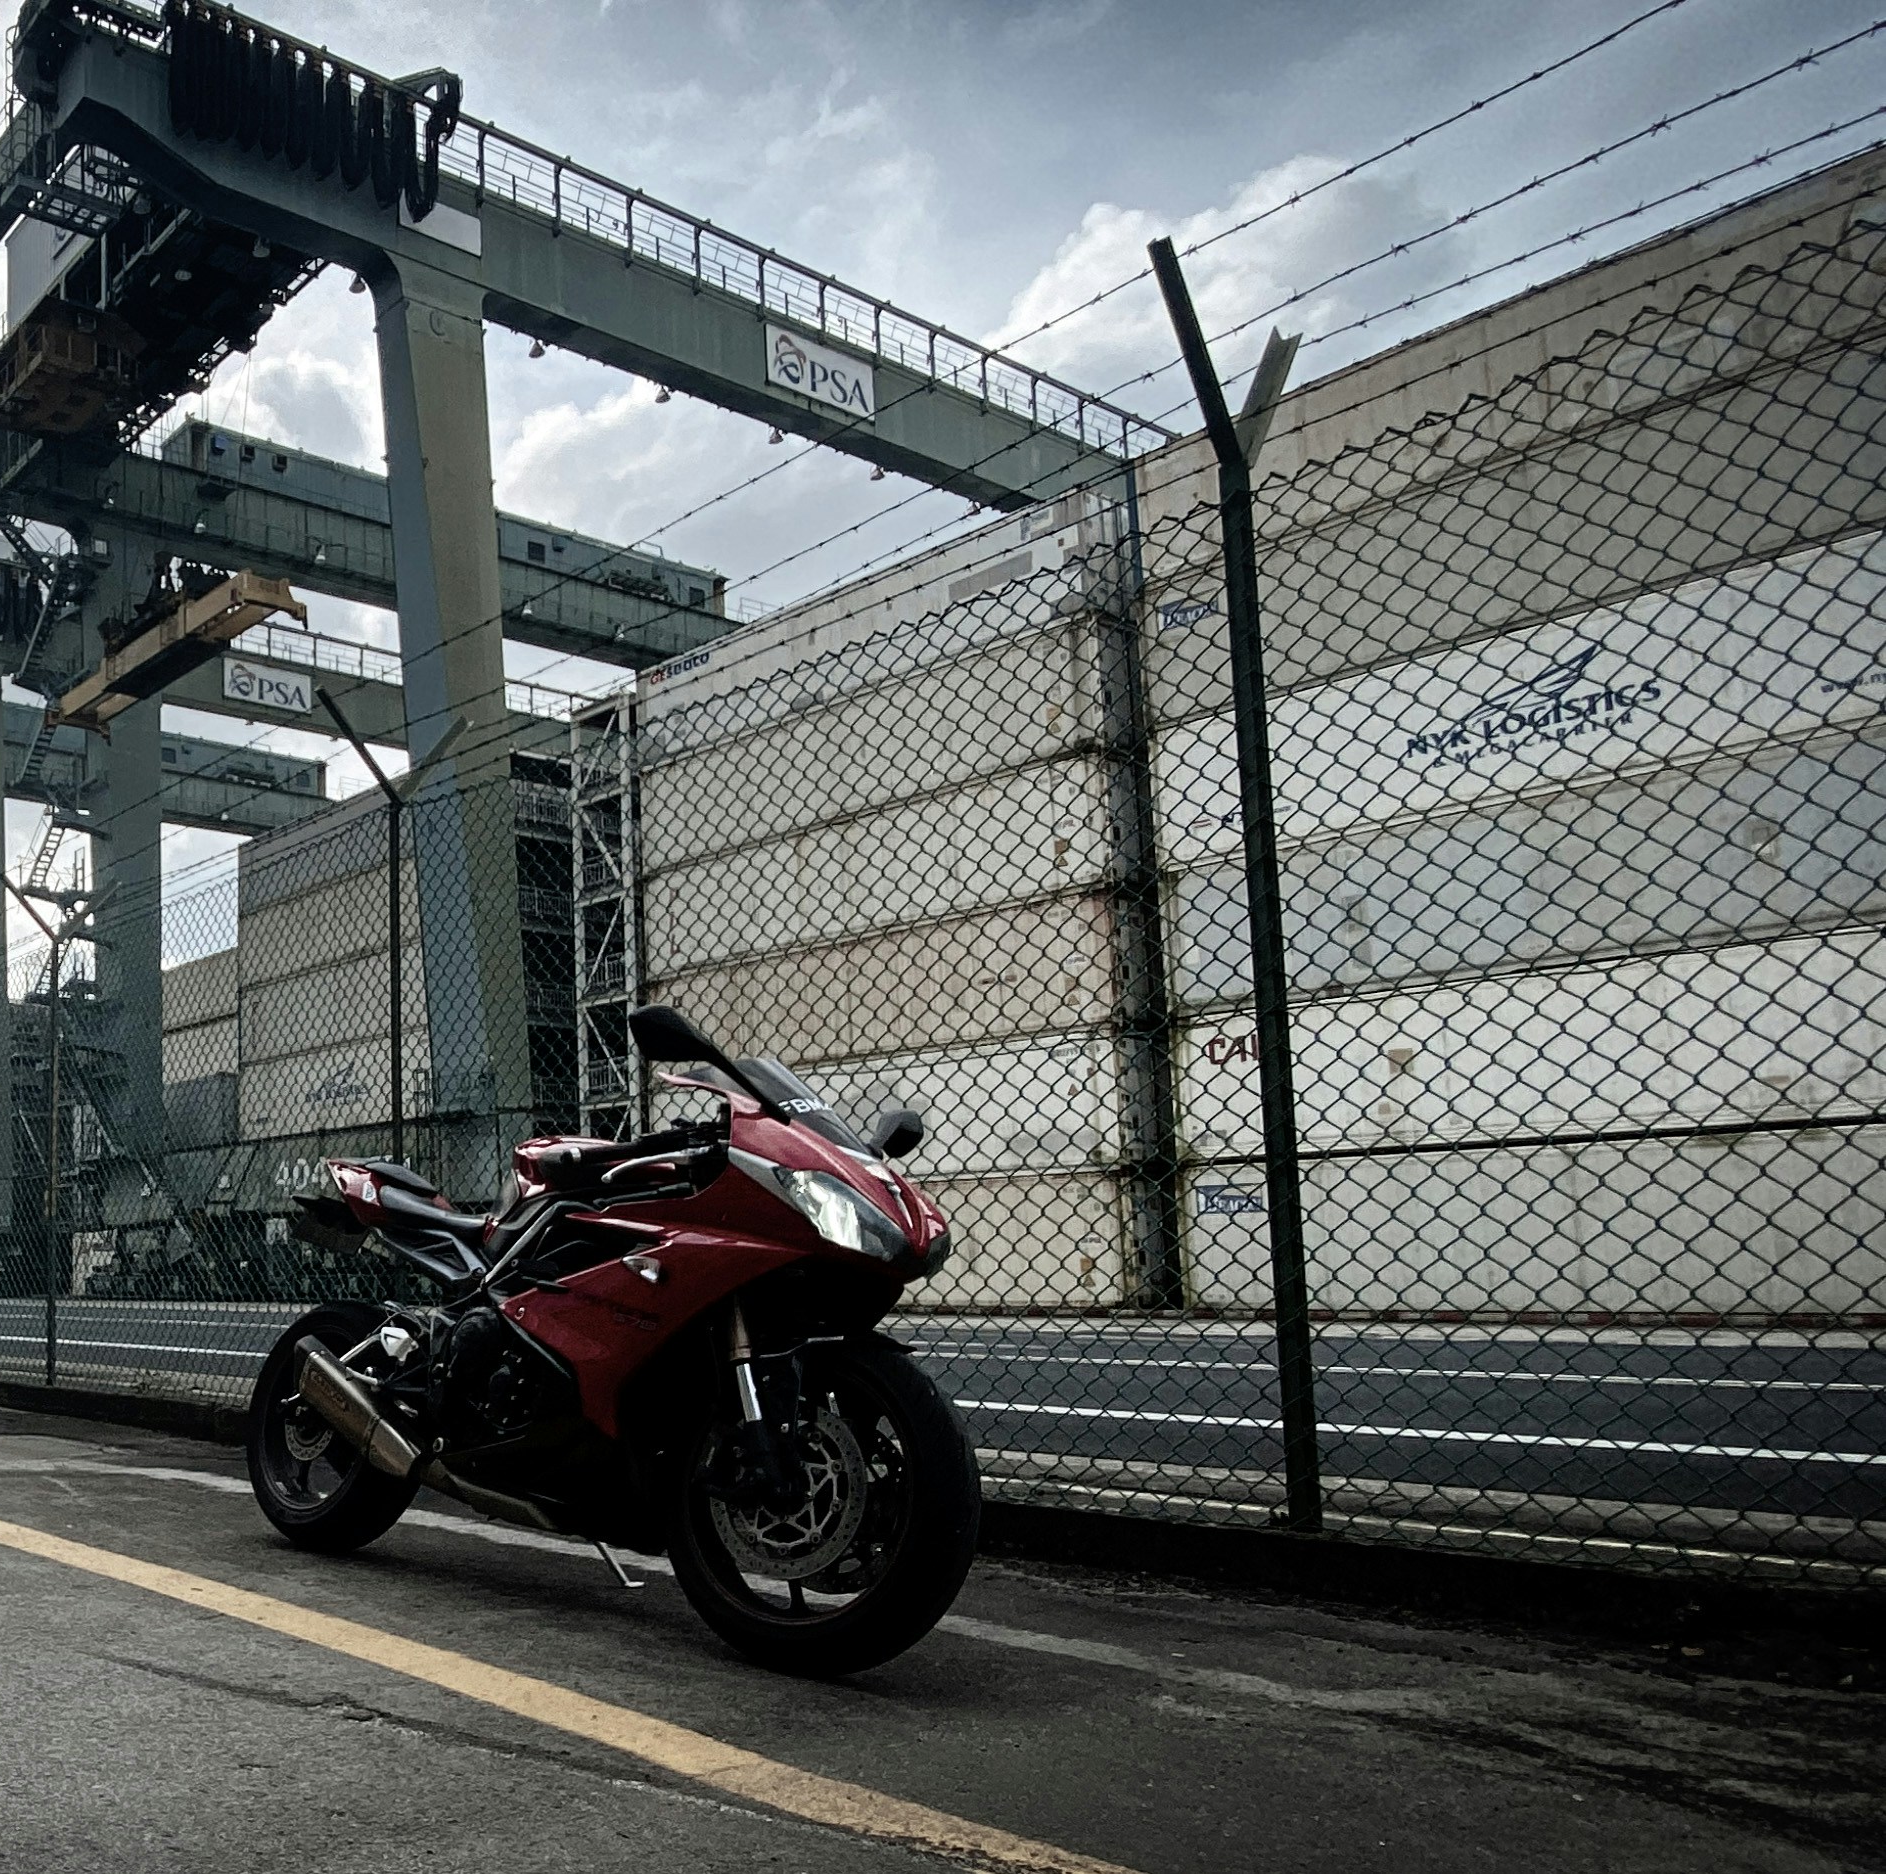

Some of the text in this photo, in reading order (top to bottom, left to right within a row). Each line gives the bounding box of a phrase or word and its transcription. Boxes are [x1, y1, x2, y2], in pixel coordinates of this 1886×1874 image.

[808, 360, 870, 413] PSA
[258, 678, 307, 709] PSA
[1408, 680, 1661, 758] NYK LOGISTICS
